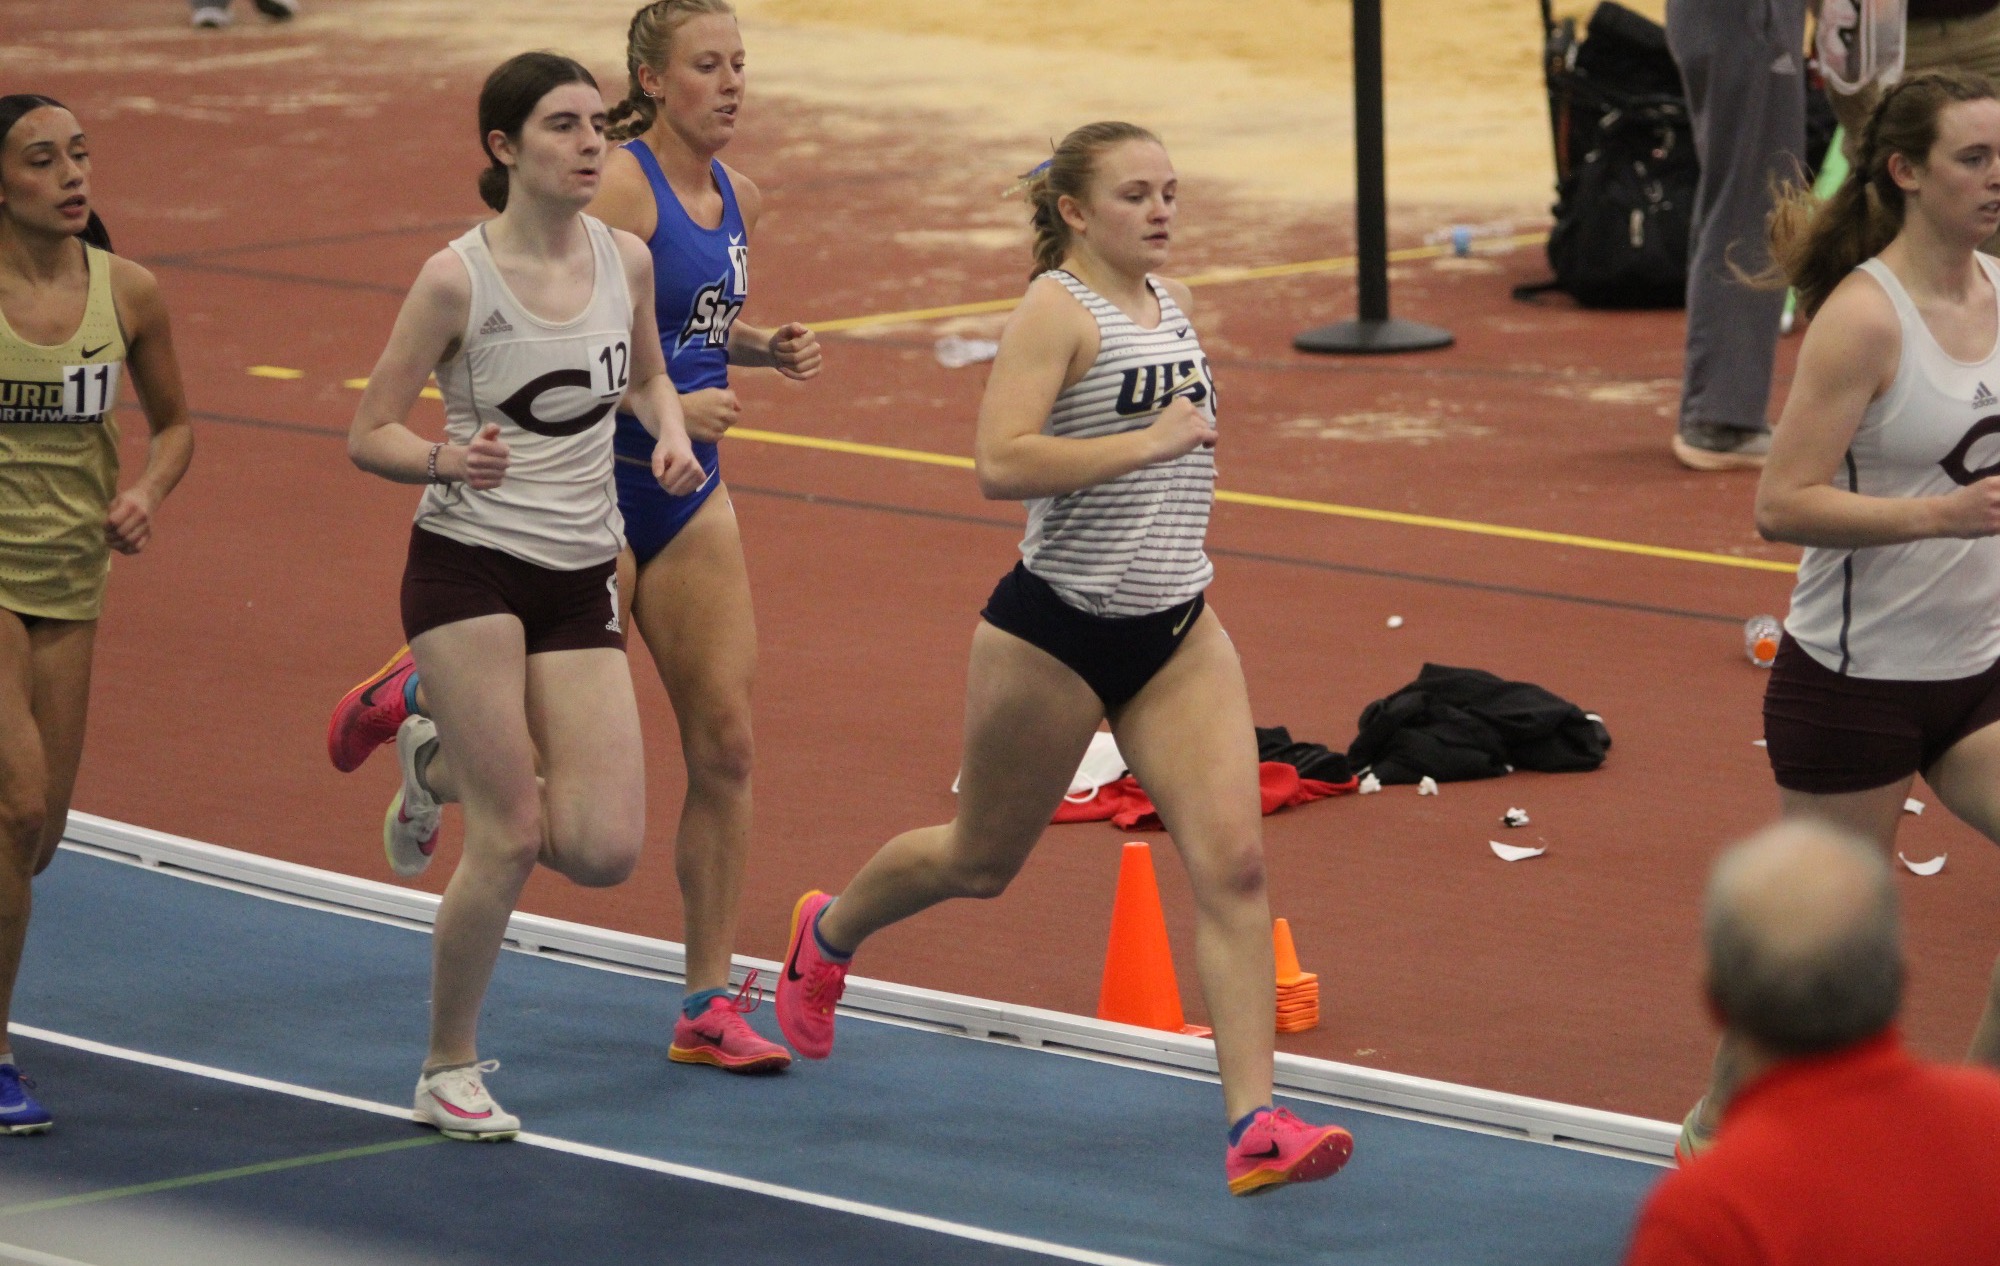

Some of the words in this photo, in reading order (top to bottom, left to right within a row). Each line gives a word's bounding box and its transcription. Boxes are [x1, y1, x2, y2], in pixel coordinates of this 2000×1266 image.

[480, 324, 513, 335] adidas
[69, 365, 108, 414] 11
[599, 341, 627, 391] 12
